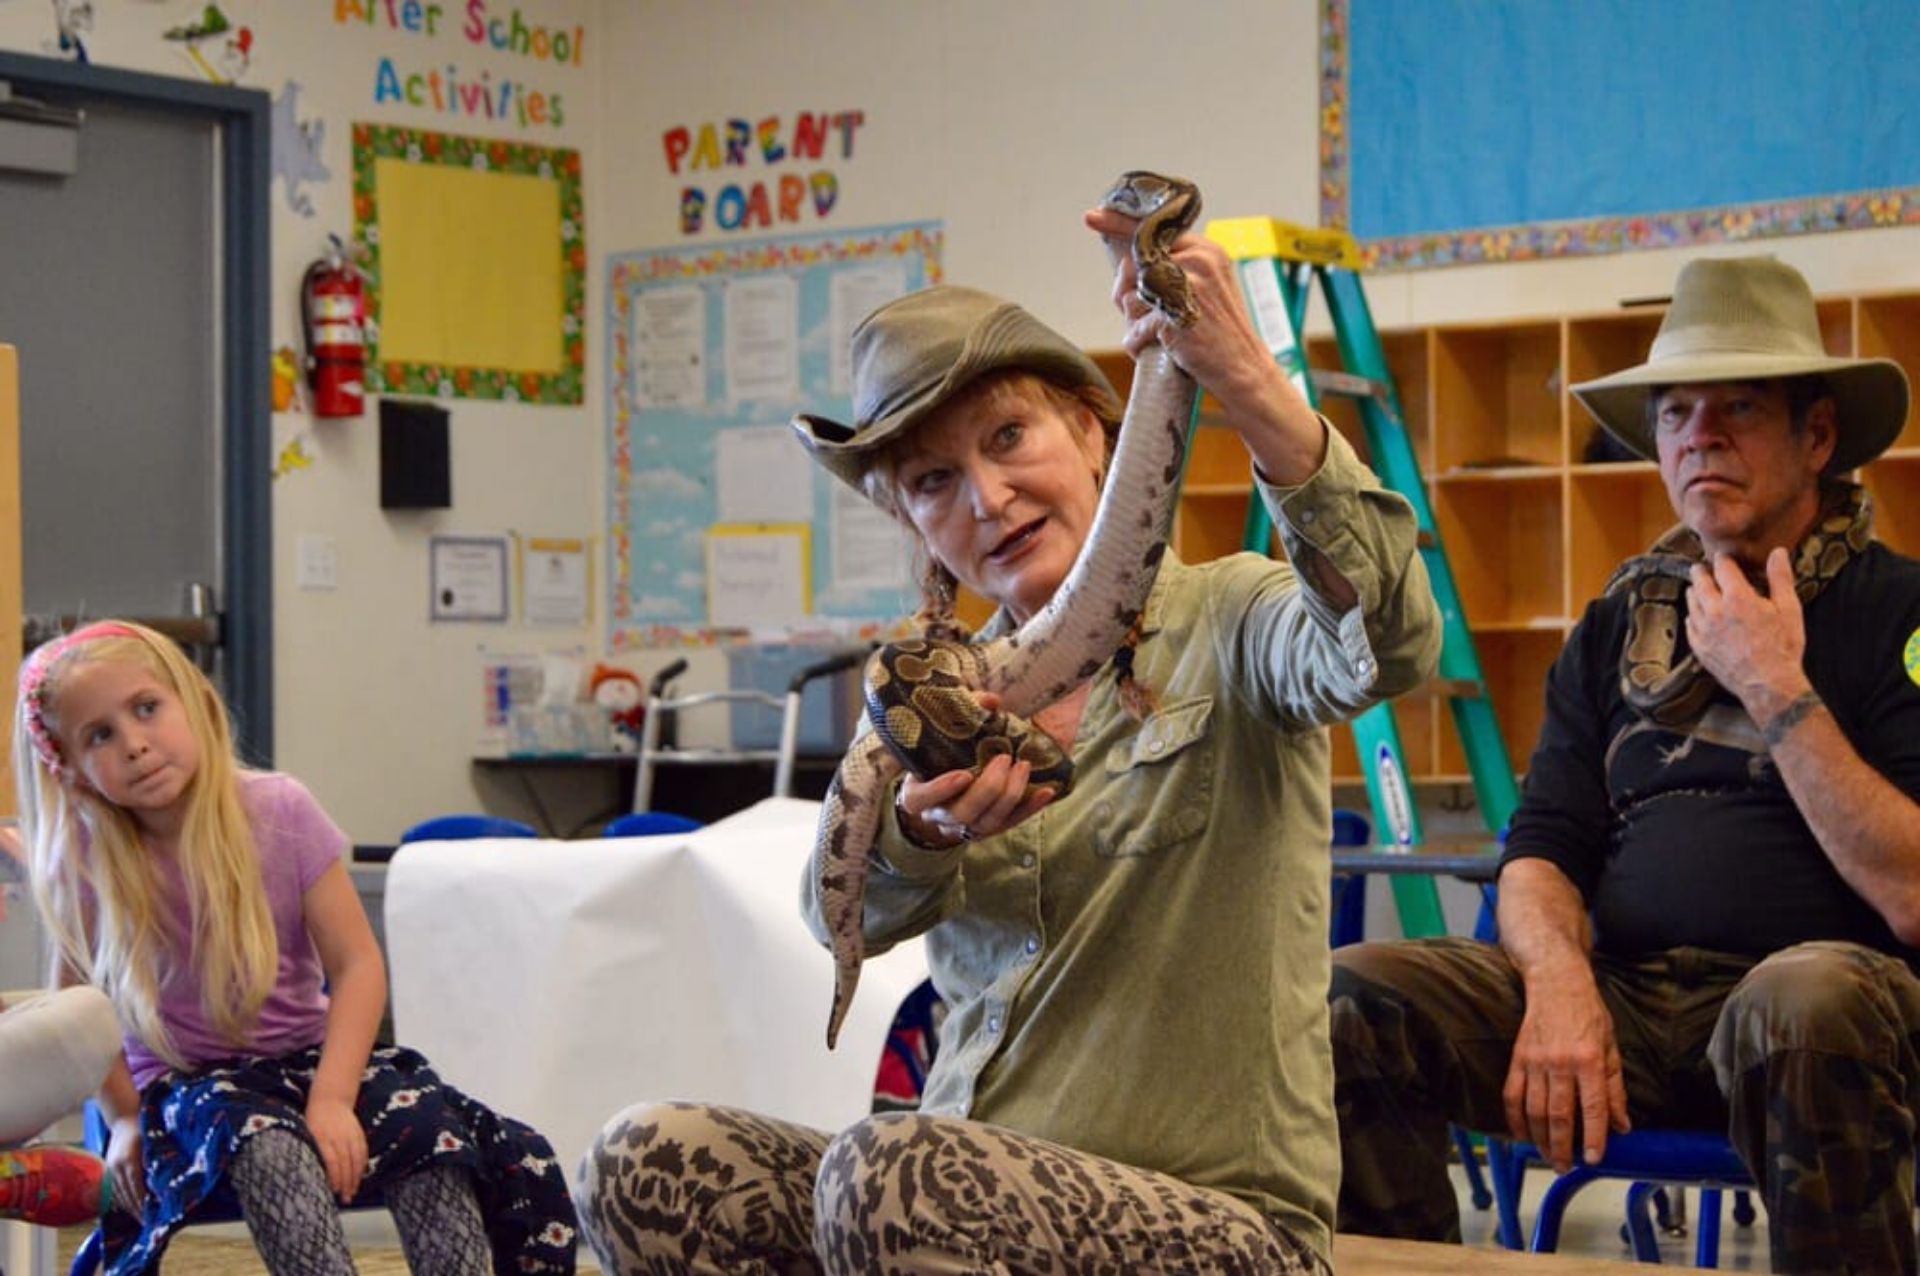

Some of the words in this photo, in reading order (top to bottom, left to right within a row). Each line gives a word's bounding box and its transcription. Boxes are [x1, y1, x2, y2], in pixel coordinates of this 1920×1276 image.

[464, 0, 584, 67] School
[374, 56, 564, 128] Activities
[663, 110, 864, 174] PARENT
[679, 170, 838, 235] BOARD
